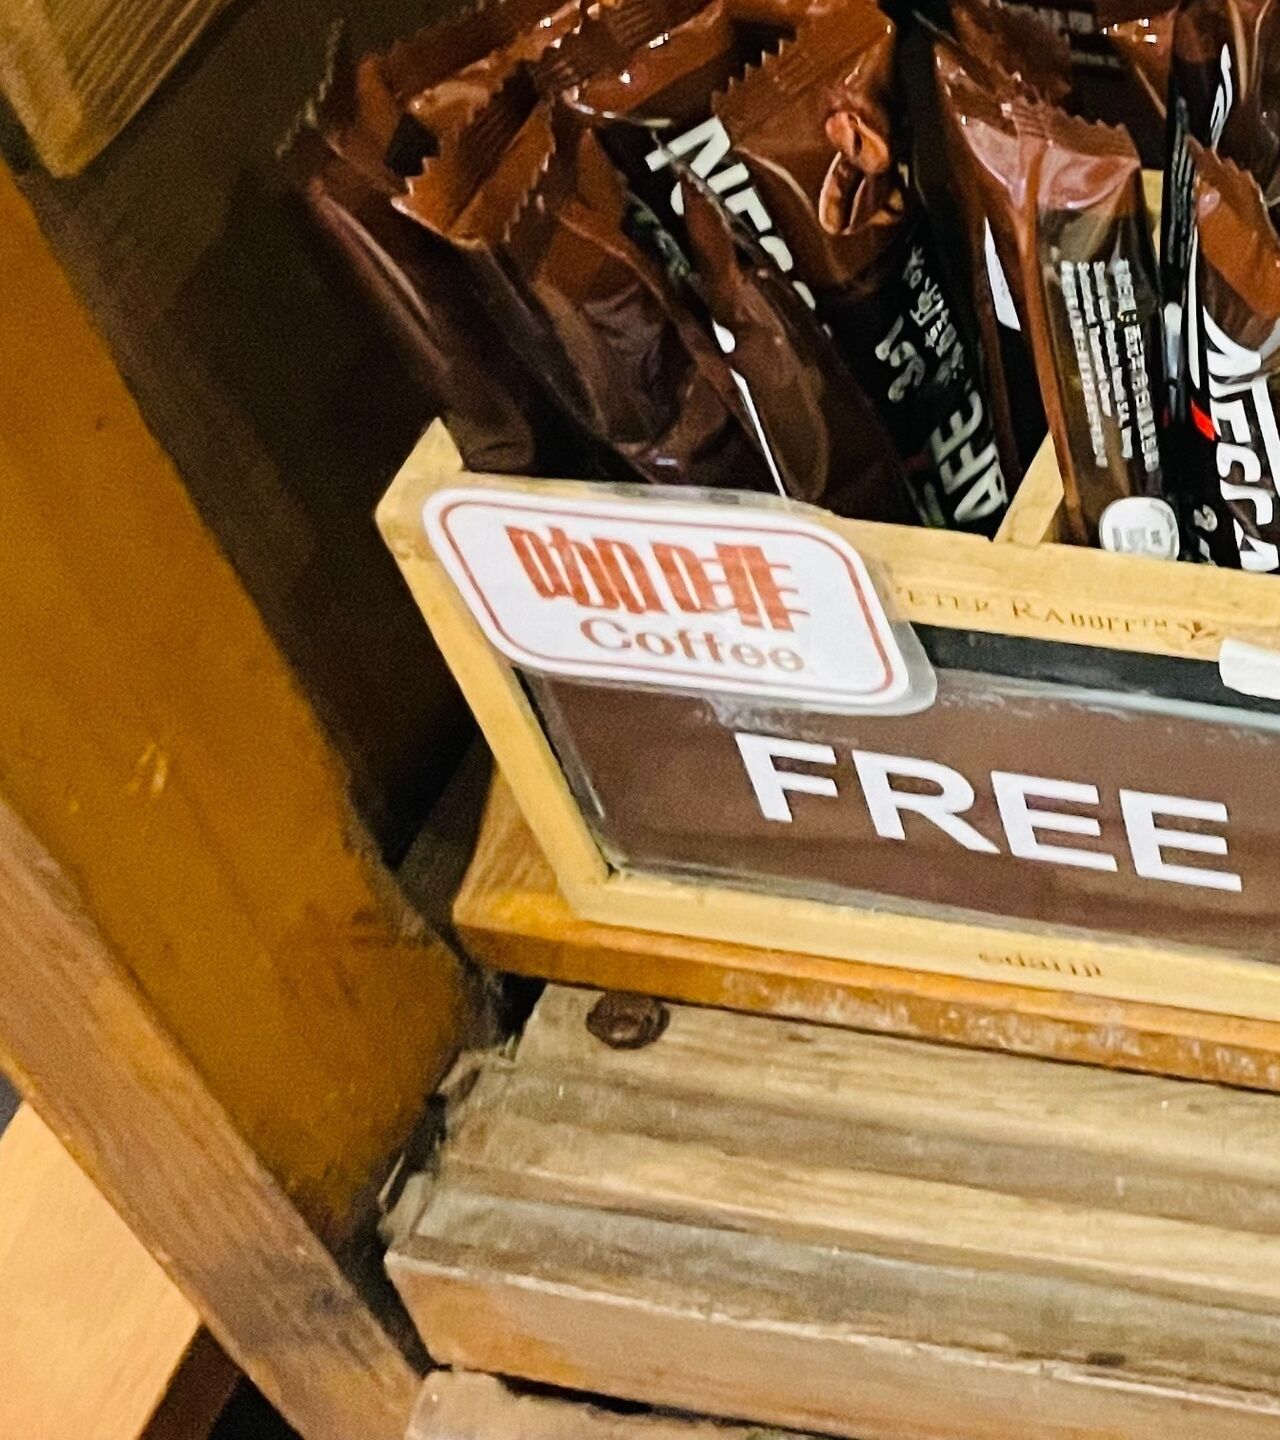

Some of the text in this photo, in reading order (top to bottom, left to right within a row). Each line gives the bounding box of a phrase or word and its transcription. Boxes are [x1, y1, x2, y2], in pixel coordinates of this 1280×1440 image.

[505, 525, 811, 632] 咖啡
[580, 616, 806, 672] Coffee
[734, 731, 1244, 893] FREE
